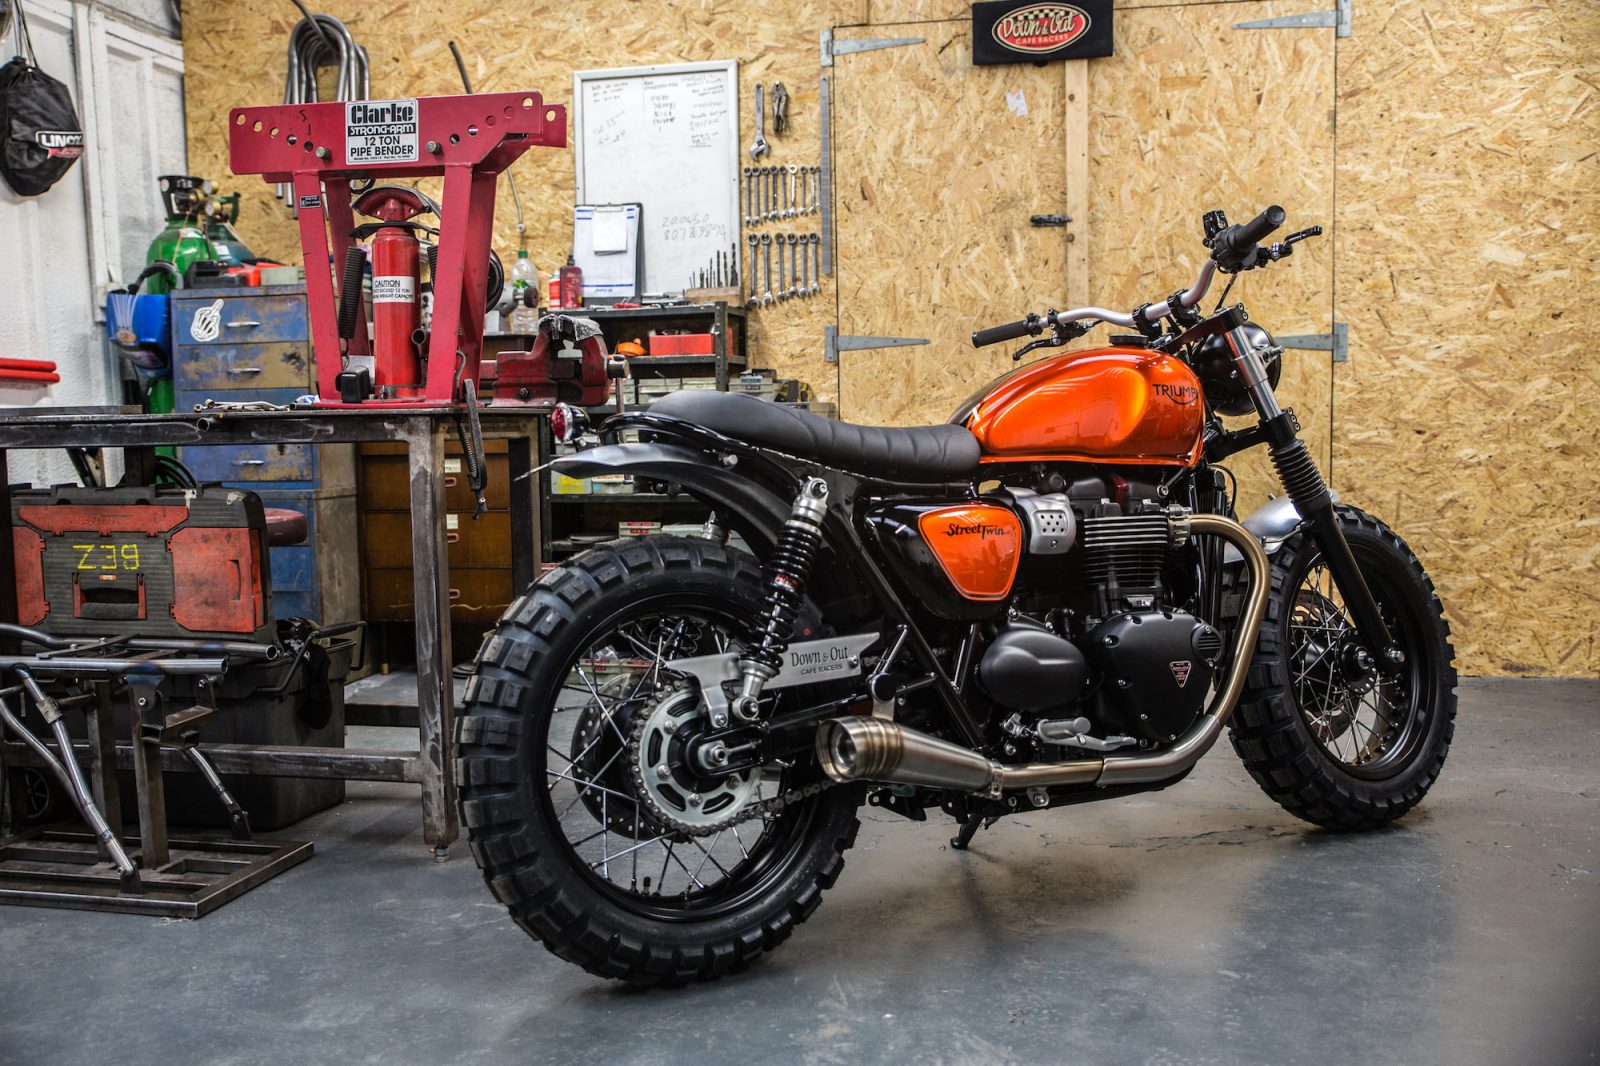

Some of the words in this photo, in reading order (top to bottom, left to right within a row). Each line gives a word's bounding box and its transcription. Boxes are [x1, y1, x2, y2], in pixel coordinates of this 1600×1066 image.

[1002, 17, 1041, 38] Down
[1015, 37, 1037, 45] CAFE
[1039, 34, 1069, 43] RACERS
[351, 103, 414, 124] Clarke
[350, 124, 414, 136] STRONG-ARM
[364, 136, 376, 146] 12
[379, 135, 400, 146] TON
[350, 147, 372, 157] PIPE
[375, 144, 414, 156] BENDER
[375, 279, 401, 288] CAUTION
[791, 651, 820, 667] Down
[830, 645, 849, 660] Out
[801, 666, 817, 675] CAFE
[819, 663, 843, 672] RACERS
